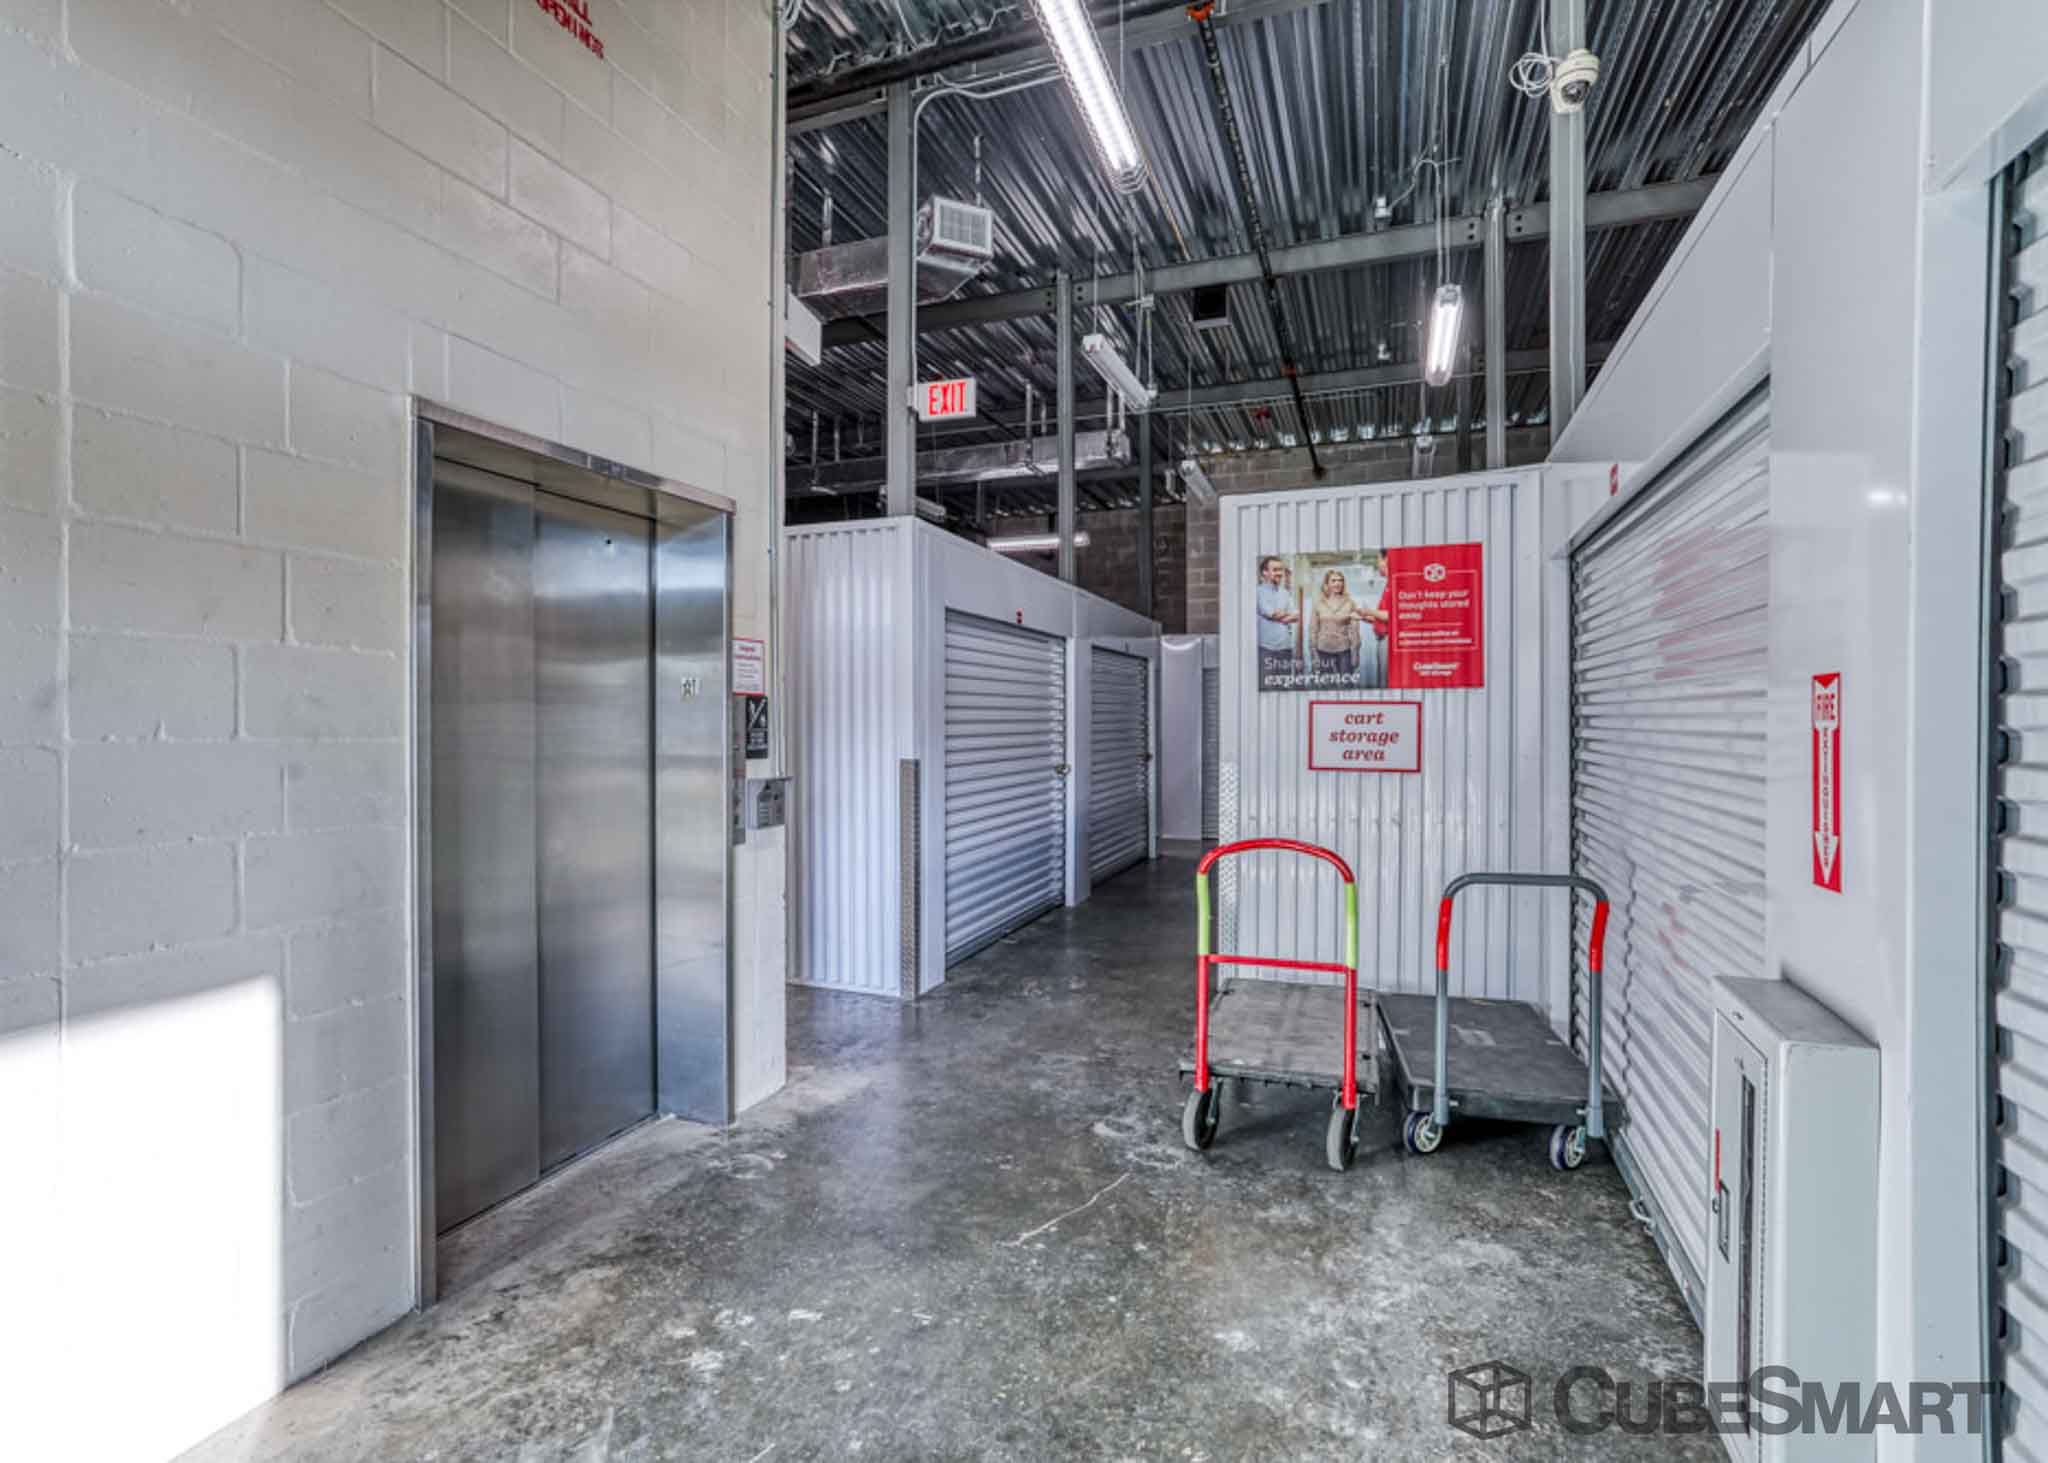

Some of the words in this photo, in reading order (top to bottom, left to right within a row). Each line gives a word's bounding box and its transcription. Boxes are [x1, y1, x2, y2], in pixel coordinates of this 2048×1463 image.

[928, 382, 966, 416] EXIT
[1264, 672, 1361, 688] experience
[1344, 712, 1384, 725] cart
[1328, 729, 1399, 746] storage
[1342, 749, 1385, 761] area
